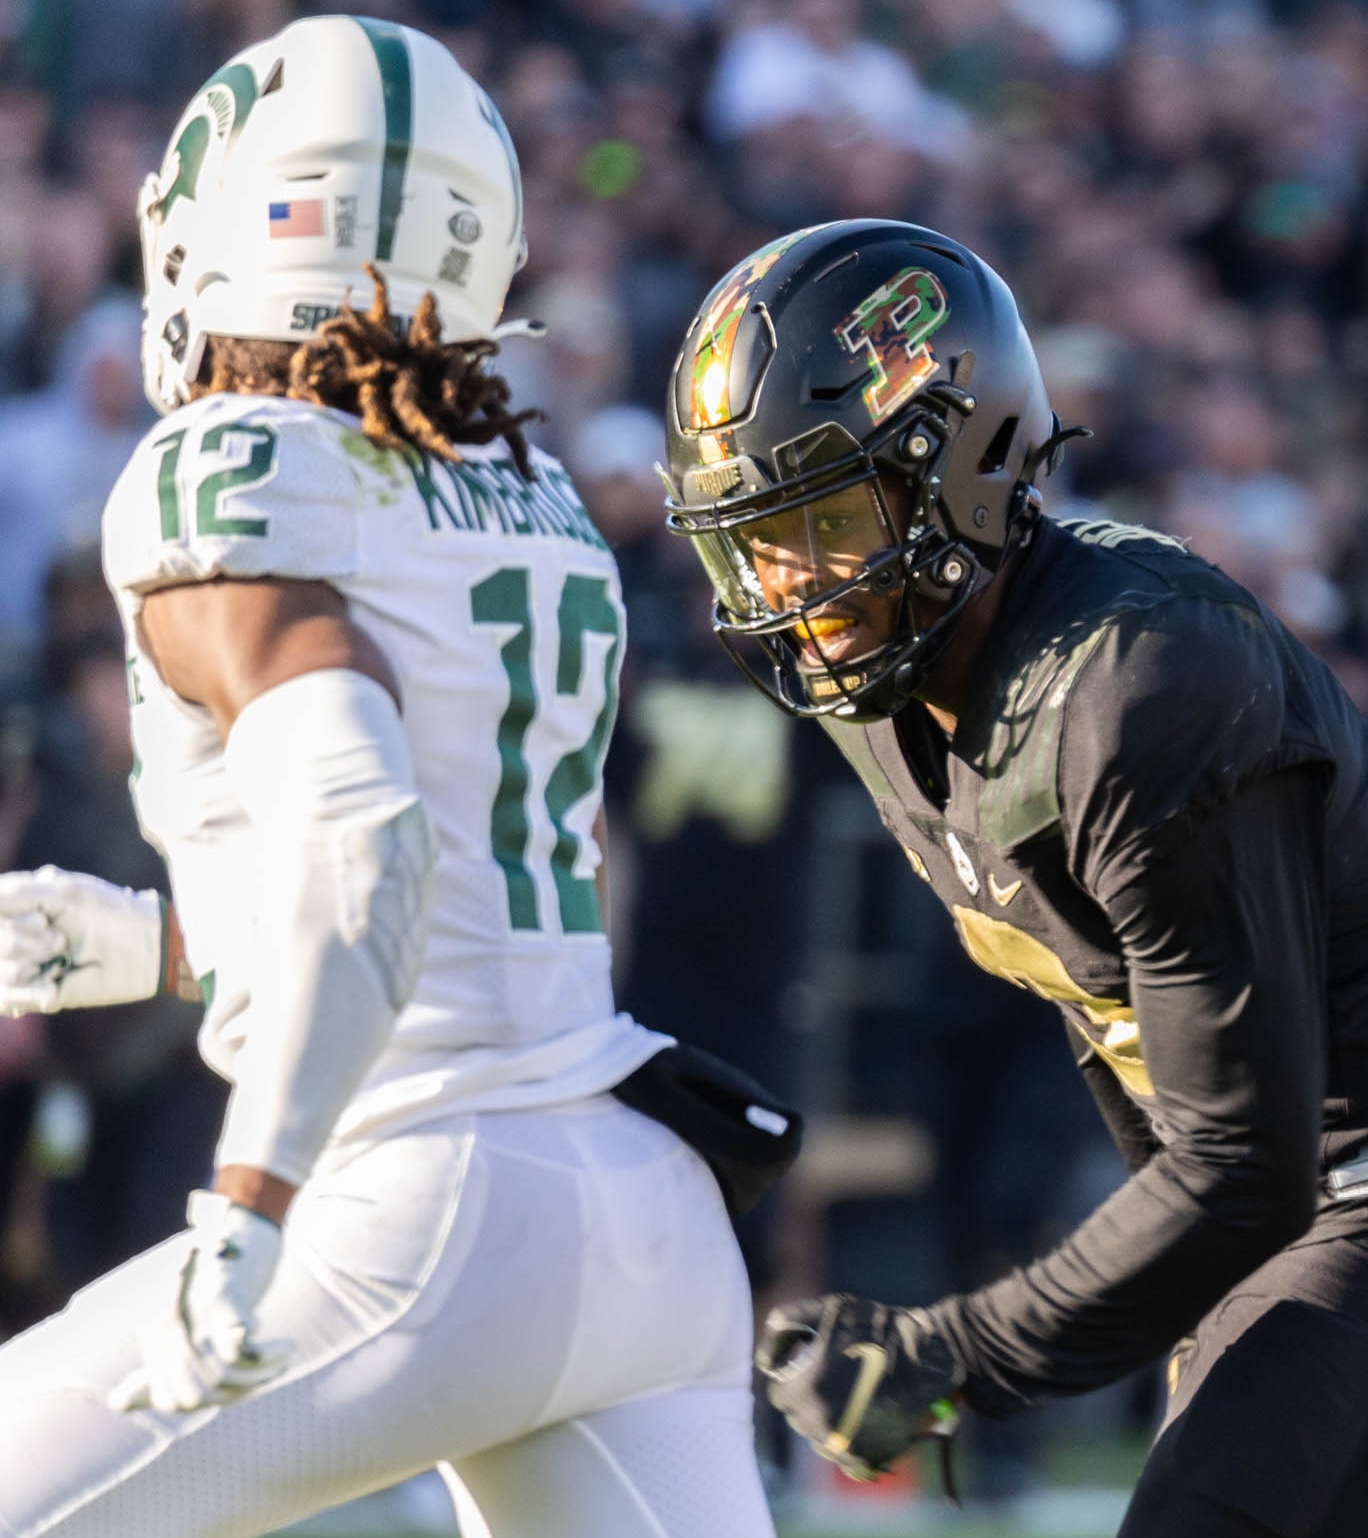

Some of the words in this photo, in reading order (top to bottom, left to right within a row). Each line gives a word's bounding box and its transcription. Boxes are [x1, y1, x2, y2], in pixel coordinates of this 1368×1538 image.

[834, 267, 951, 427] P
[154, 423, 277, 540] 12
[470, 565, 619, 934] 12
